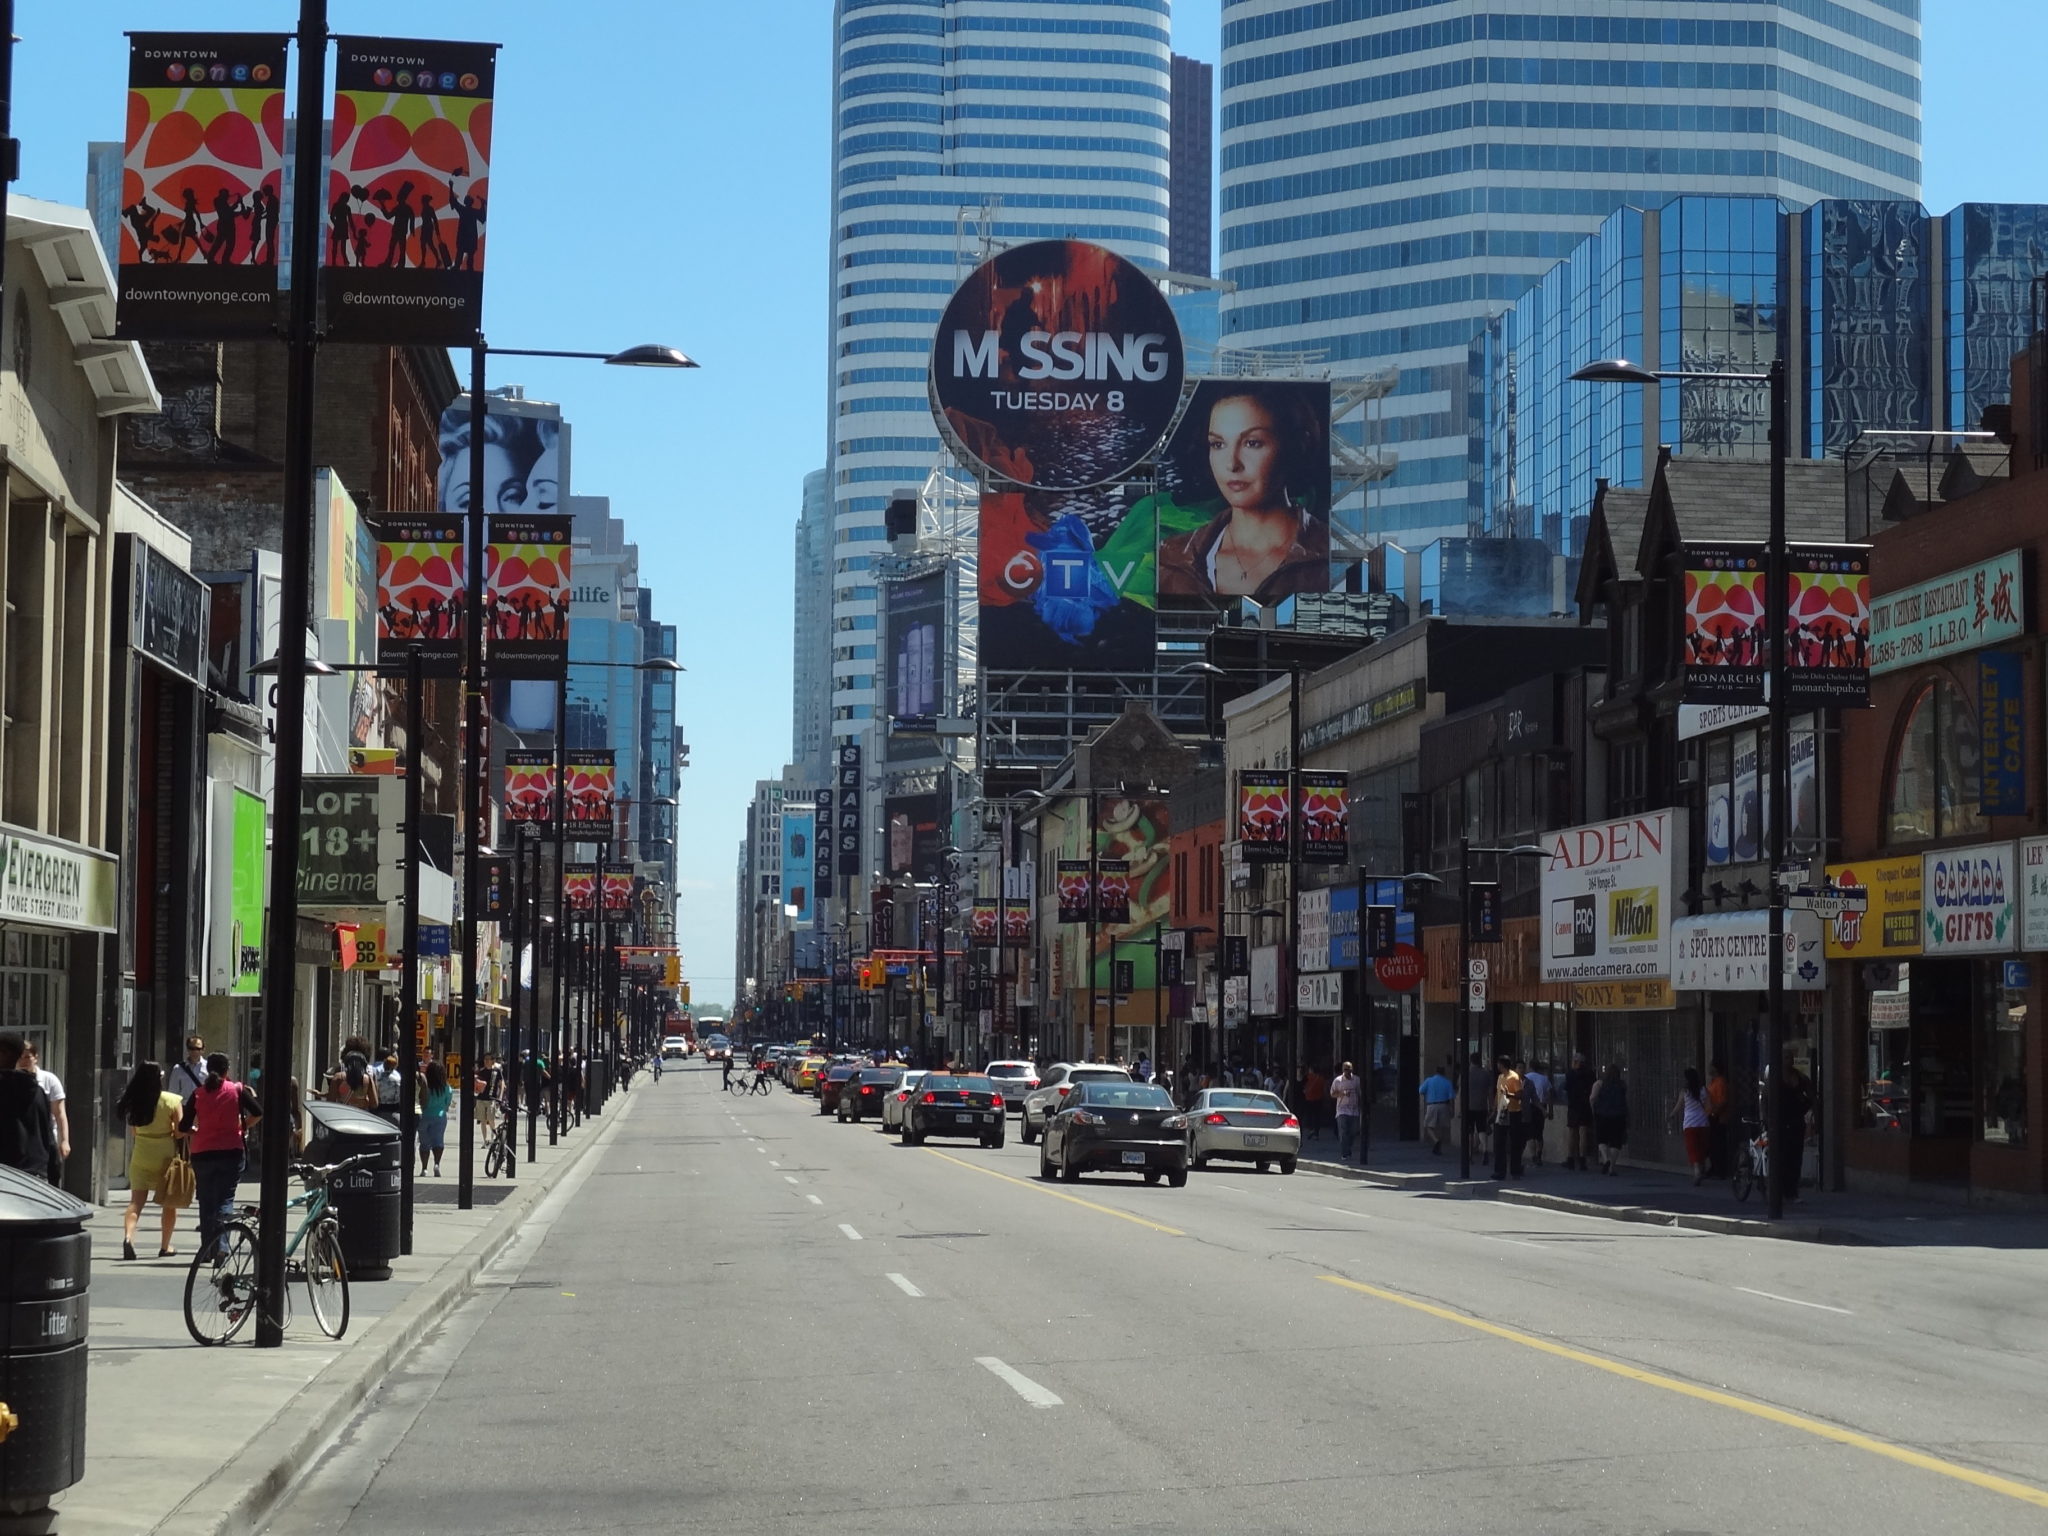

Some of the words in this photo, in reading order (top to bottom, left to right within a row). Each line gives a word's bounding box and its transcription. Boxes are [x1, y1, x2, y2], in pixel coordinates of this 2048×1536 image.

[144, 50, 218, 59] DOWNTOWN
[351, 54, 426, 66] DOWNTOWN
[125, 288, 270, 304] downtownyonge.com
[342, 291, 465, 309] @downtownyonge
[953, 330, 1169, 382] MSSING
[990, 390, 1099, 412] TUESDAY
[1107, 390, 1125, 412] 8
[1004, 551, 1137, 592] CTV
[1873, 604, 1891, 635] TOWN
[1894, 595, 1921, 628] CHINESE
[1925, 579, 1969, 619] RESTAURANT
[1688, 673, 1762, 684] MONARCHS
[1792, 683, 1866, 695] monarchspub.ca
[1699, 705, 1726, 729] SPORTS
[1982, 663, 2000, 806] INTERNET
[2004, 698, 2020, 772] CAFE
[1791, 736, 1814, 766] GAME
[843, 748, 857, 850] SEARS
[302, 826, 377, 856] 18+
[818, 791, 830, 877] SEARS
[1548, 815, 1666, 872] ADEN
[8, 838, 81, 898] EVERGREEN
[2026, 846, 2043, 866] LEE
[1935, 856, 2005, 907] CANADA
[7, 894, 28, 913] YONGE
[31, 898, 55, 917] STREET
[57, 903, 79, 920] MISSION
[1807, 897, 1838, 909] Walton
[1841, 899, 1850, 909] St
[1575, 908, 1593, 935] PRO
[1614, 896, 1654, 936] Nikon
[1885, 915, 1914, 928] WESTERN
[1946, 912, 1993, 942] GIFTS
[1555, 922, 1572, 936] Canon
[1832, 912, 1864, 945] Mart
[1894, 929, 1914, 942] UNION
[1690, 936, 1725, 958] SPORTS
[1727, 935, 1767, 957] CENTRE
[1382, 964, 1418, 978] CHALET
[1388, 954, 1414, 965] SWISS
[1547, 962, 1658, 978] www.adencamera.com
[1575, 986, 1615, 1006] SONY
[350, 1175, 375, 1188] Litter
[41, 1310, 68, 1336] Litter
